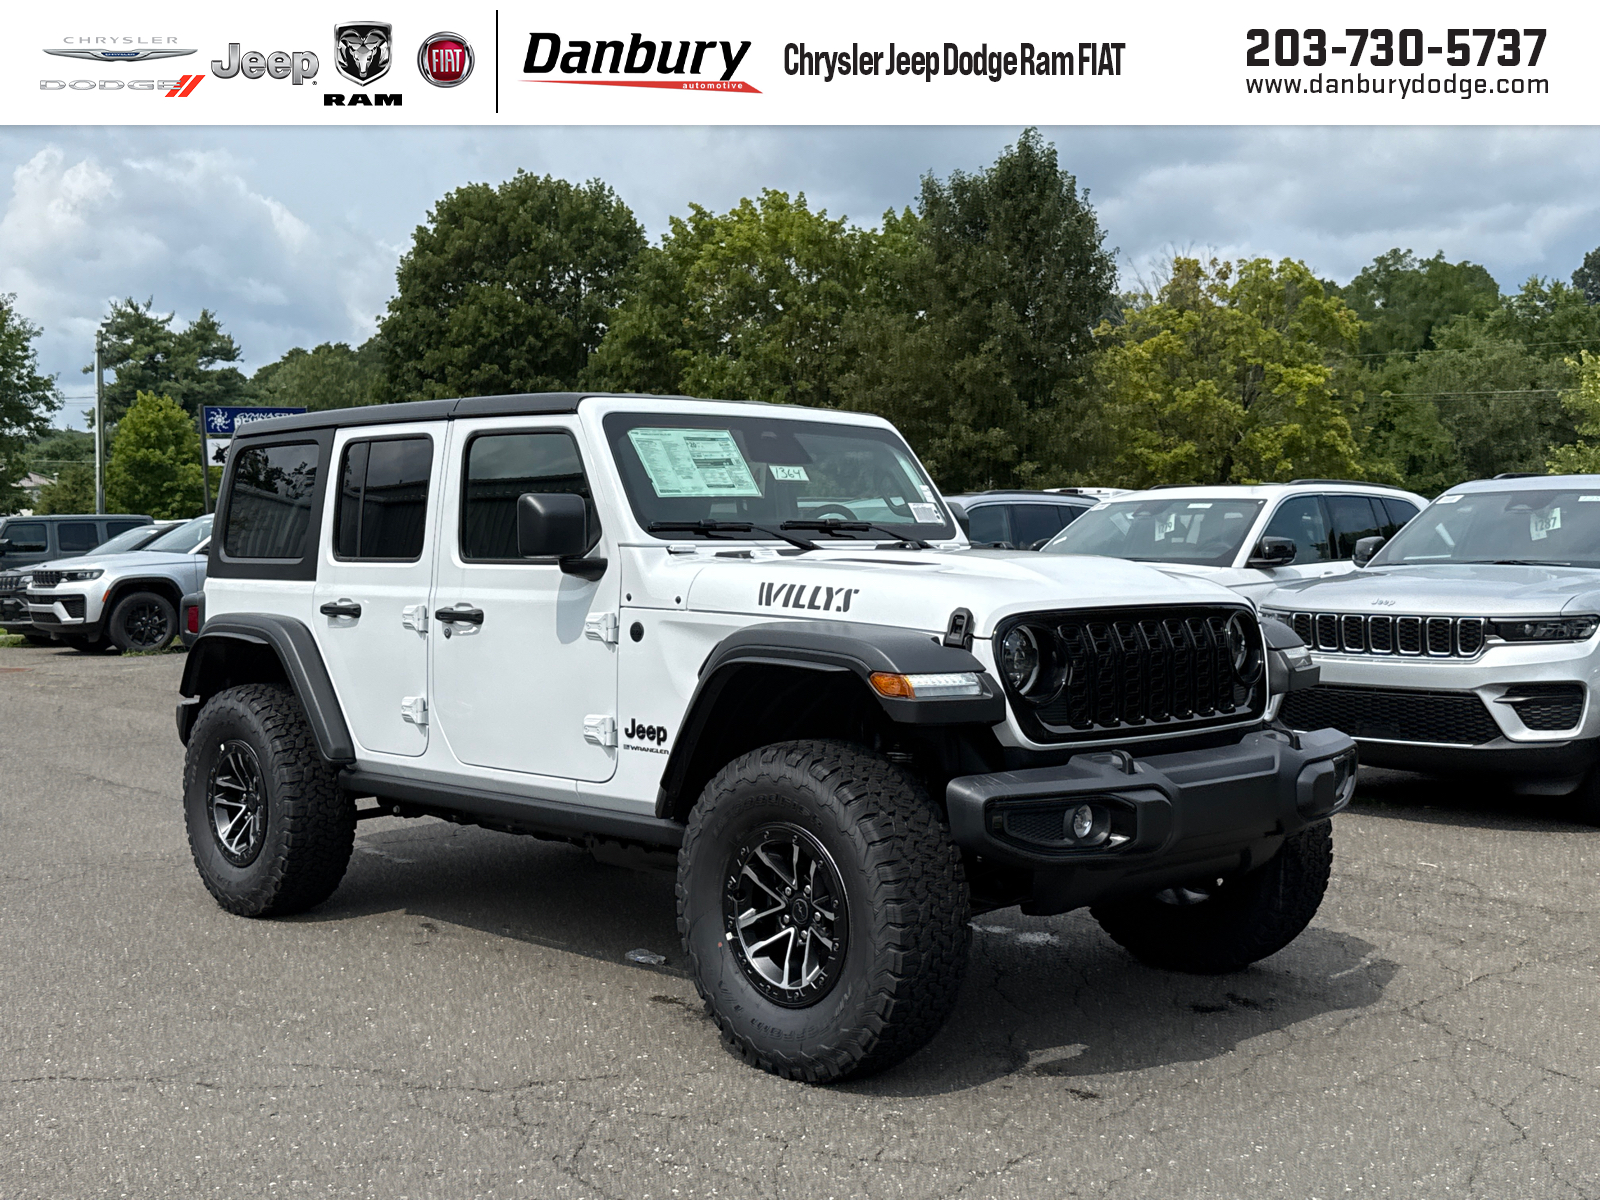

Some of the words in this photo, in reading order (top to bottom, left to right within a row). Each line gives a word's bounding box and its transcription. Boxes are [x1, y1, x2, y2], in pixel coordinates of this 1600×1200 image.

[774, 466, 802, 480] 1364
[1533, 516, 1557, 532] 1287
[758, 582, 860, 612] WILLYS
[1371, 597, 1396, 607] Jeep
[624, 717, 668, 747] Jeep
[630, 744, 670, 755] WRANGLER
